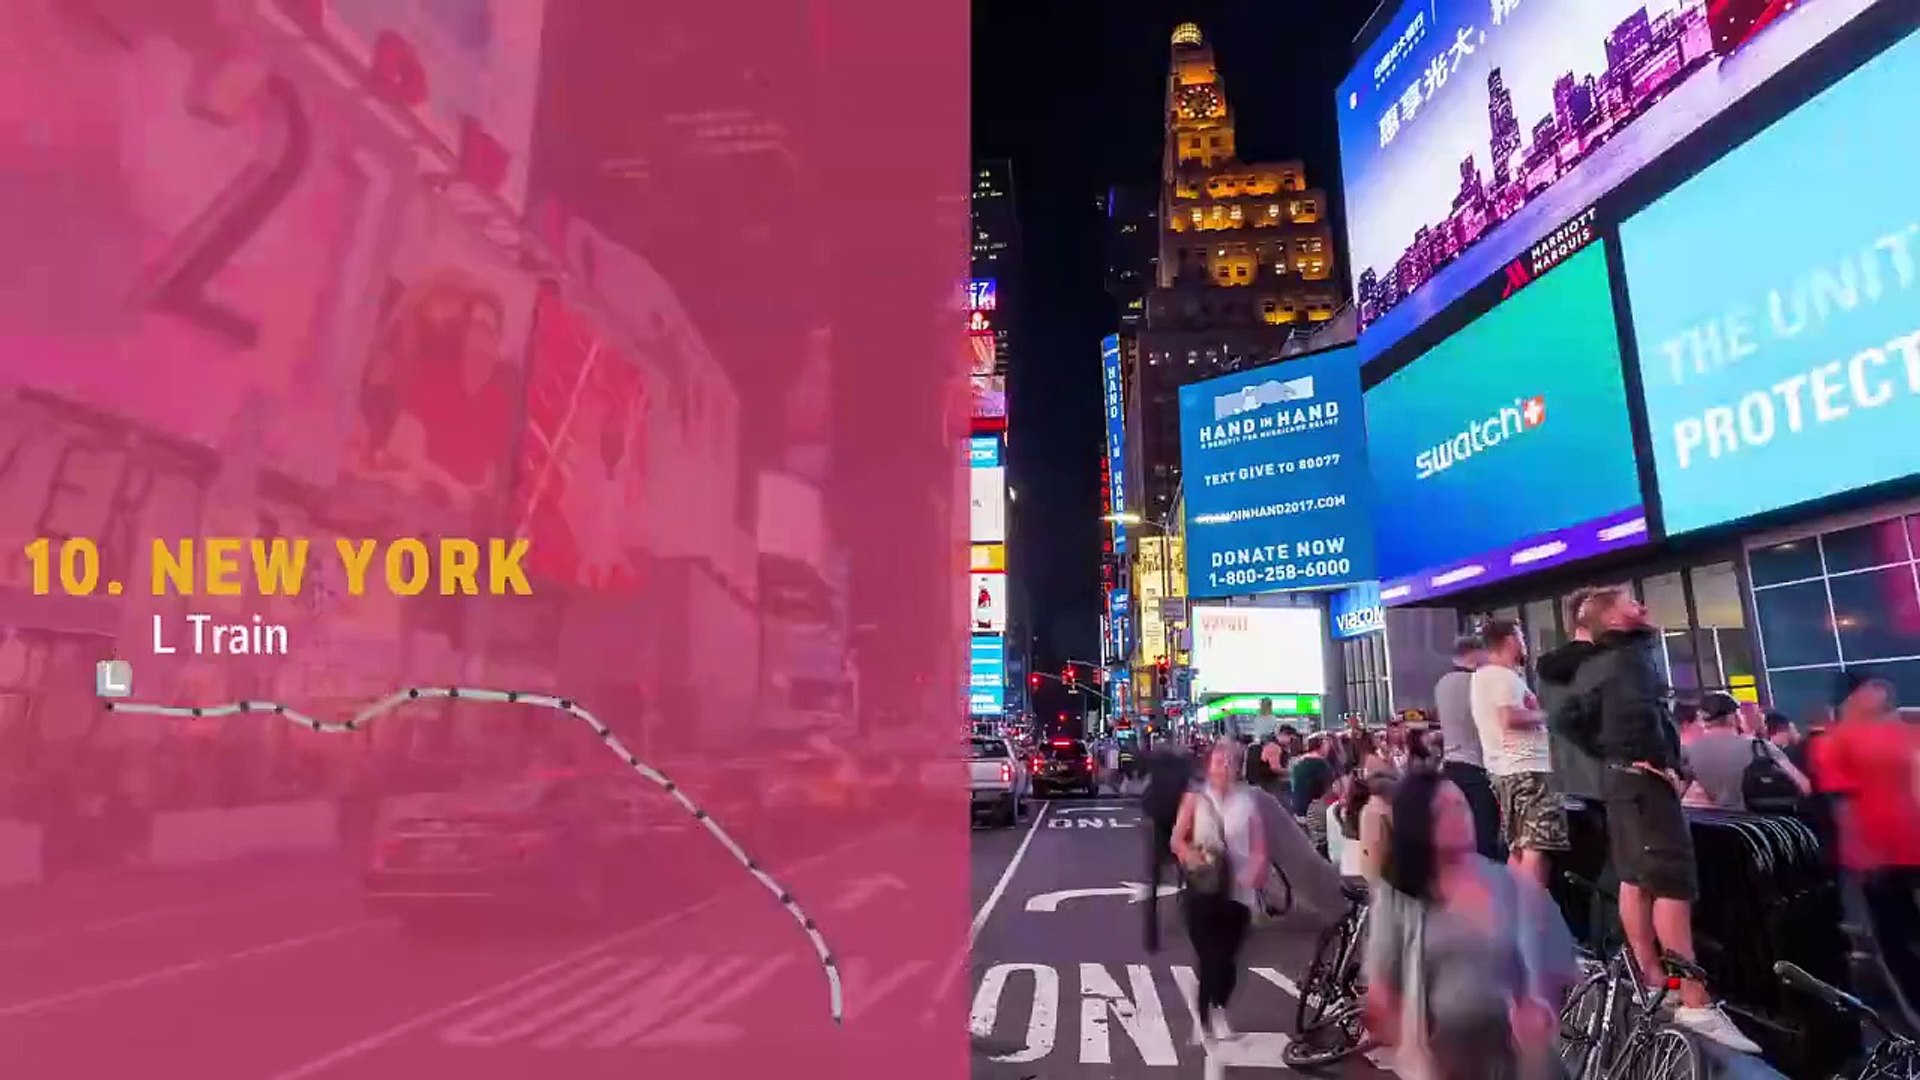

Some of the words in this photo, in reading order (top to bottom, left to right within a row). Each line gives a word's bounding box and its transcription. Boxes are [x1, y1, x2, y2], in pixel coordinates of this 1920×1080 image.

[1531, 207, 1596, 260] MARRIOTT
[1534, 228, 1590, 275] MARQUIS
[1660, 309, 1758, 385] THE
[1767, 224, 1920, 338] UNIT
[1107, 366, 1118, 418] HAND
[1674, 330, 1920, 468] PROTECT
[1200, 418, 1255, 443] HAND
[1260, 416, 1272, 428] IN
[1277, 401, 1339, 427] HAND
[1416, 402, 1523, 480] swatch
[1205, 471, 1236, 487] TEXT
[1239, 463, 1276, 480] GIVE
[1278, 462, 1295, 474] TO
[1299, 453, 1341, 470] 80077
[1209, 559, 1350, 588] 1-800-258-6000
[1212, 544, 1289, 567] DONATE
[1297, 537, 1346, 556] NOW
[1048, 817, 1141, 830] ONL
